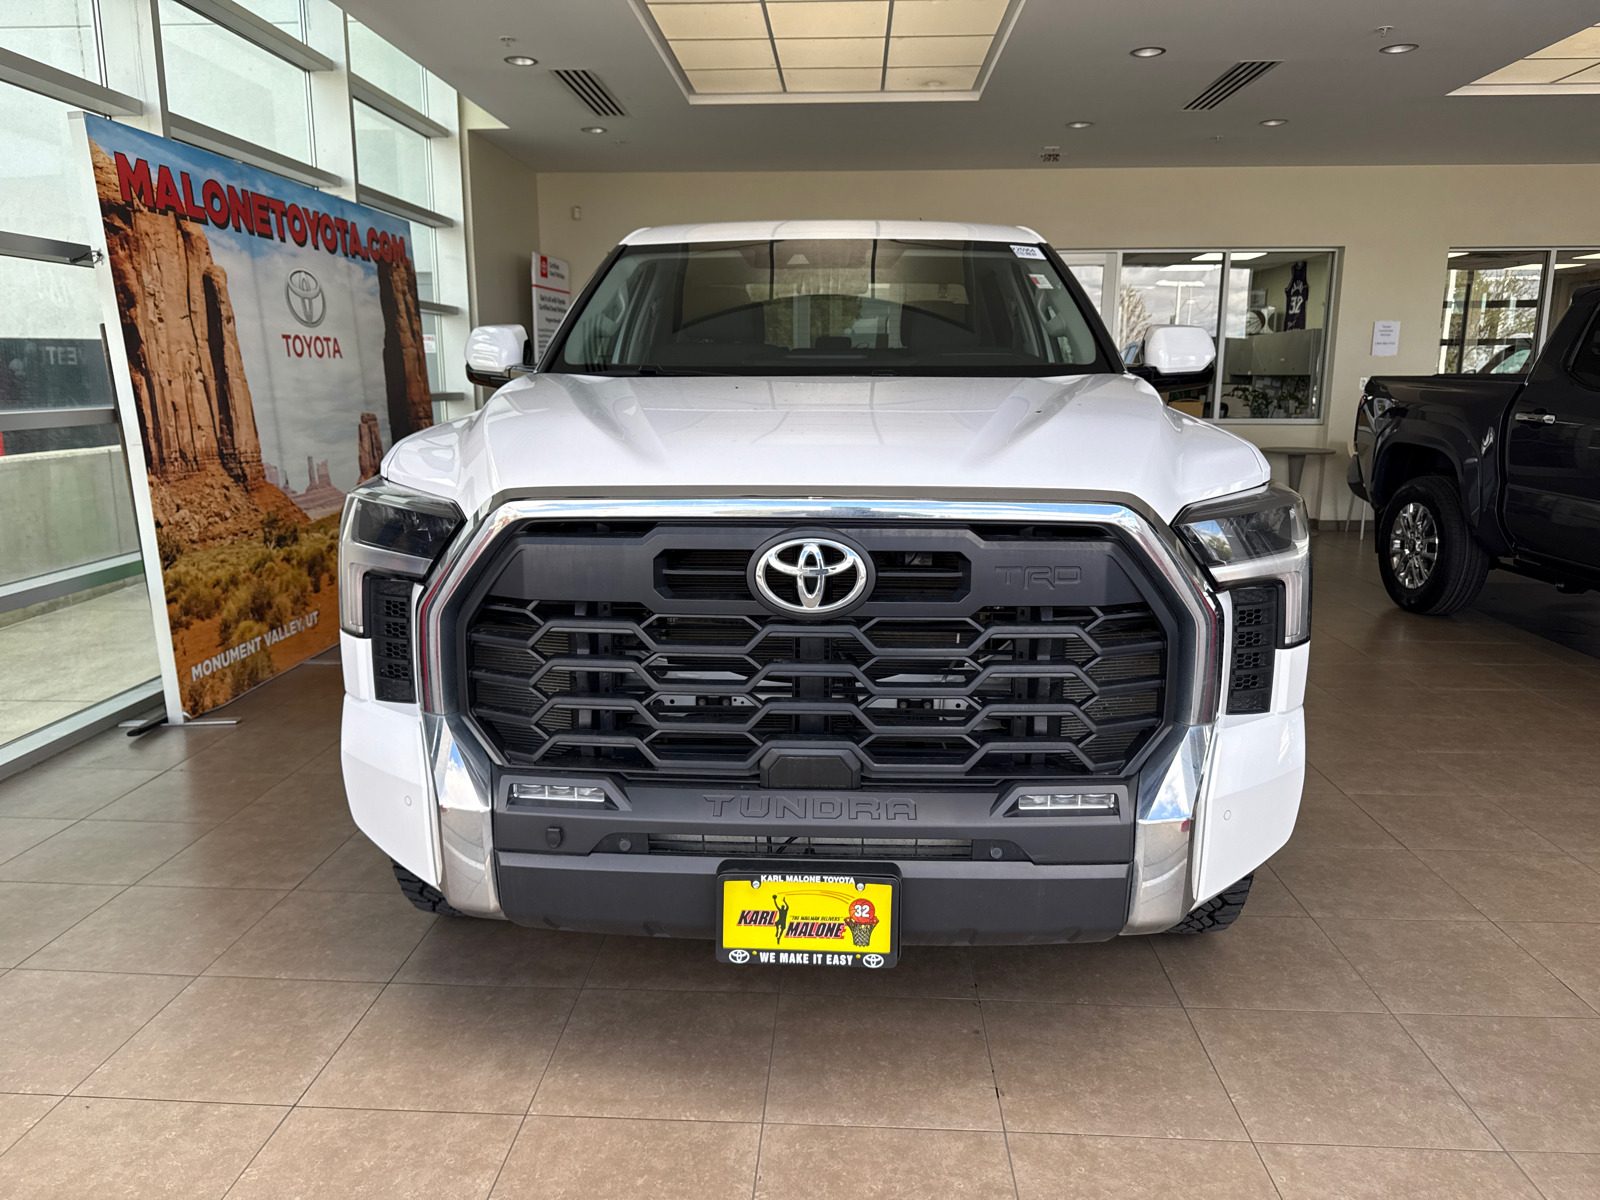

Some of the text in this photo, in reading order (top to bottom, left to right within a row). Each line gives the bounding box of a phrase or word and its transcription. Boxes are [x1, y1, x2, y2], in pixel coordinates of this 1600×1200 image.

[113, 151, 409, 266] MALONETOYOTA.COM
[1289, 296, 1304, 314] 32
[281, 333, 343, 359] TOYOTA
[995, 566, 1082, 590] TRD
[191, 610, 319, 682] MONUMENT VALLEY, UT
[702, 794, 917, 820] TUNDRA
[760, 874, 855, 884] KARL MALONE TOYOTA
[736, 909, 778, 926] KARL
[854, 904, 870, 918] 32
[784, 921, 847, 939] MALONE
[759, 951, 853, 966] WE MAKE IT EASY
